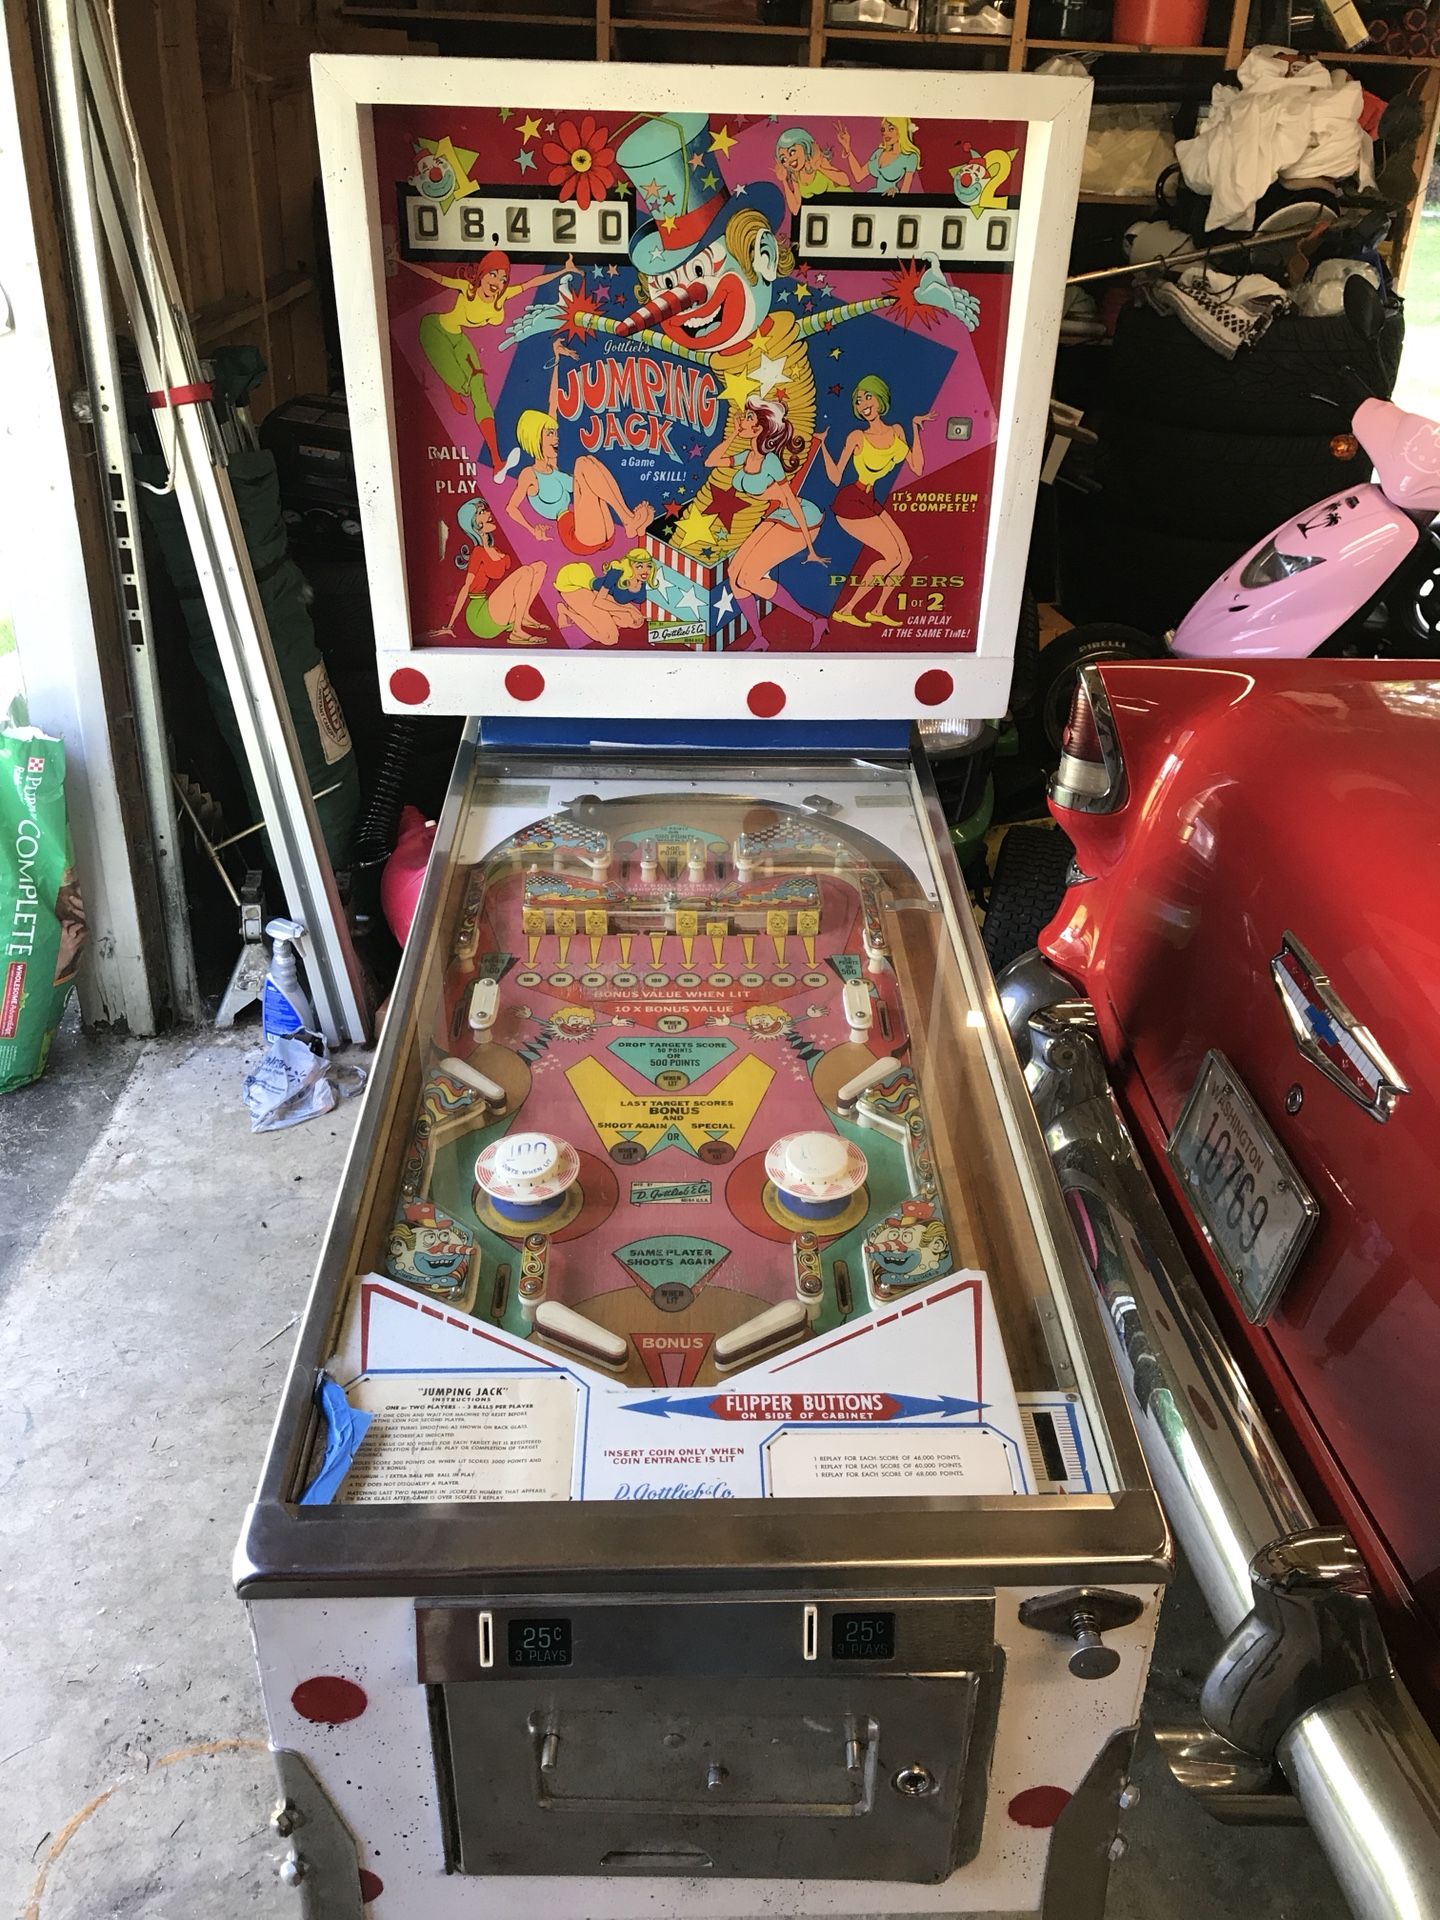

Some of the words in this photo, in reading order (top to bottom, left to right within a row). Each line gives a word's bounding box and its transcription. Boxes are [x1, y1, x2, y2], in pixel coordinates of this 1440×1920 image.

[604, 339, 651, 355] Gottlieb's
[557, 357, 718, 434] JUMPING
[579, 413, 678, 456] JACK
[428, 446, 470, 460] BALL
[621, 459, 627, 467] a
[628, 456, 655, 467] Game
[459, 462, 477, 476] IN
[640, 470, 652, 481] of
[653, 471, 687, 482] SKILL!
[436, 480, 477, 494] PLAY
[892, 491, 912, 502] IT'S
[916, 493, 952, 502] MORE
[955, 493, 978, 503] FUN
[892, 503, 908, 512] TO
[829, 575, 965, 587] PLAYERS
[897, 593, 907, 610] 1
[911, 598, 924, 607] or
[927, 593, 945, 611] 2
[907, 616, 926, 625] CAN
[928, 616, 952, 625] PLAY
[662, 626, 691, 640] Gottlieb
[881, 629, 895, 638] AT
[896, 629, 914, 638] THE
[916, 629, 943, 638] SAME
[944, 629, 971, 638] TIME!
[1079, 640, 1126, 652] PIRELLI
[5, 819, 41, 957] COMPLETE
[10, 964, 24, 1006] WHOLESOME
[594, 991, 639, 999] BONUS
[730, 990, 751, 998] LIT
[650, 1059, 667, 1067] 500
[670, 1059, 701, 1067] POINTS
[649, 1107, 700, 1115] BONUS
[1210, 1082, 1264, 1174] WASHINGTON
[667, 1133, 680, 1141] OR
[1194, 1112, 1269, 1254] 10769
[650, 1186, 690, 1200] Gottlieb
[627, 1258, 673, 1266] SHOOTS
[642, 1337, 704, 1349] BONUS
[726, 1395, 793, 1411] FLIPPER
[802, 1395, 883, 1411] BUTTONS
[741, 1412, 757, 1420] ON
[764, 1412, 792, 1420] SIDE
[604, 1449, 645, 1457] INSERT
[678, 1448, 707, 1456] ONLY
[710, 1447, 745, 1455] WHEN
[613, 1457, 641, 1465] COIN
[644, 1456, 701, 1464] ENTRANCE
[718, 1455, 736, 1463] LIT
[633, 1482, 705, 1500] Gottlieb
[523, 1626, 562, 1649] 25¢
[846, 1621, 885, 1642] 25¢
[851, 1642, 888, 1655] PLAYS
[515, 1649, 524, 1661] 3
[528, 1649, 567, 1663] PLAYS
